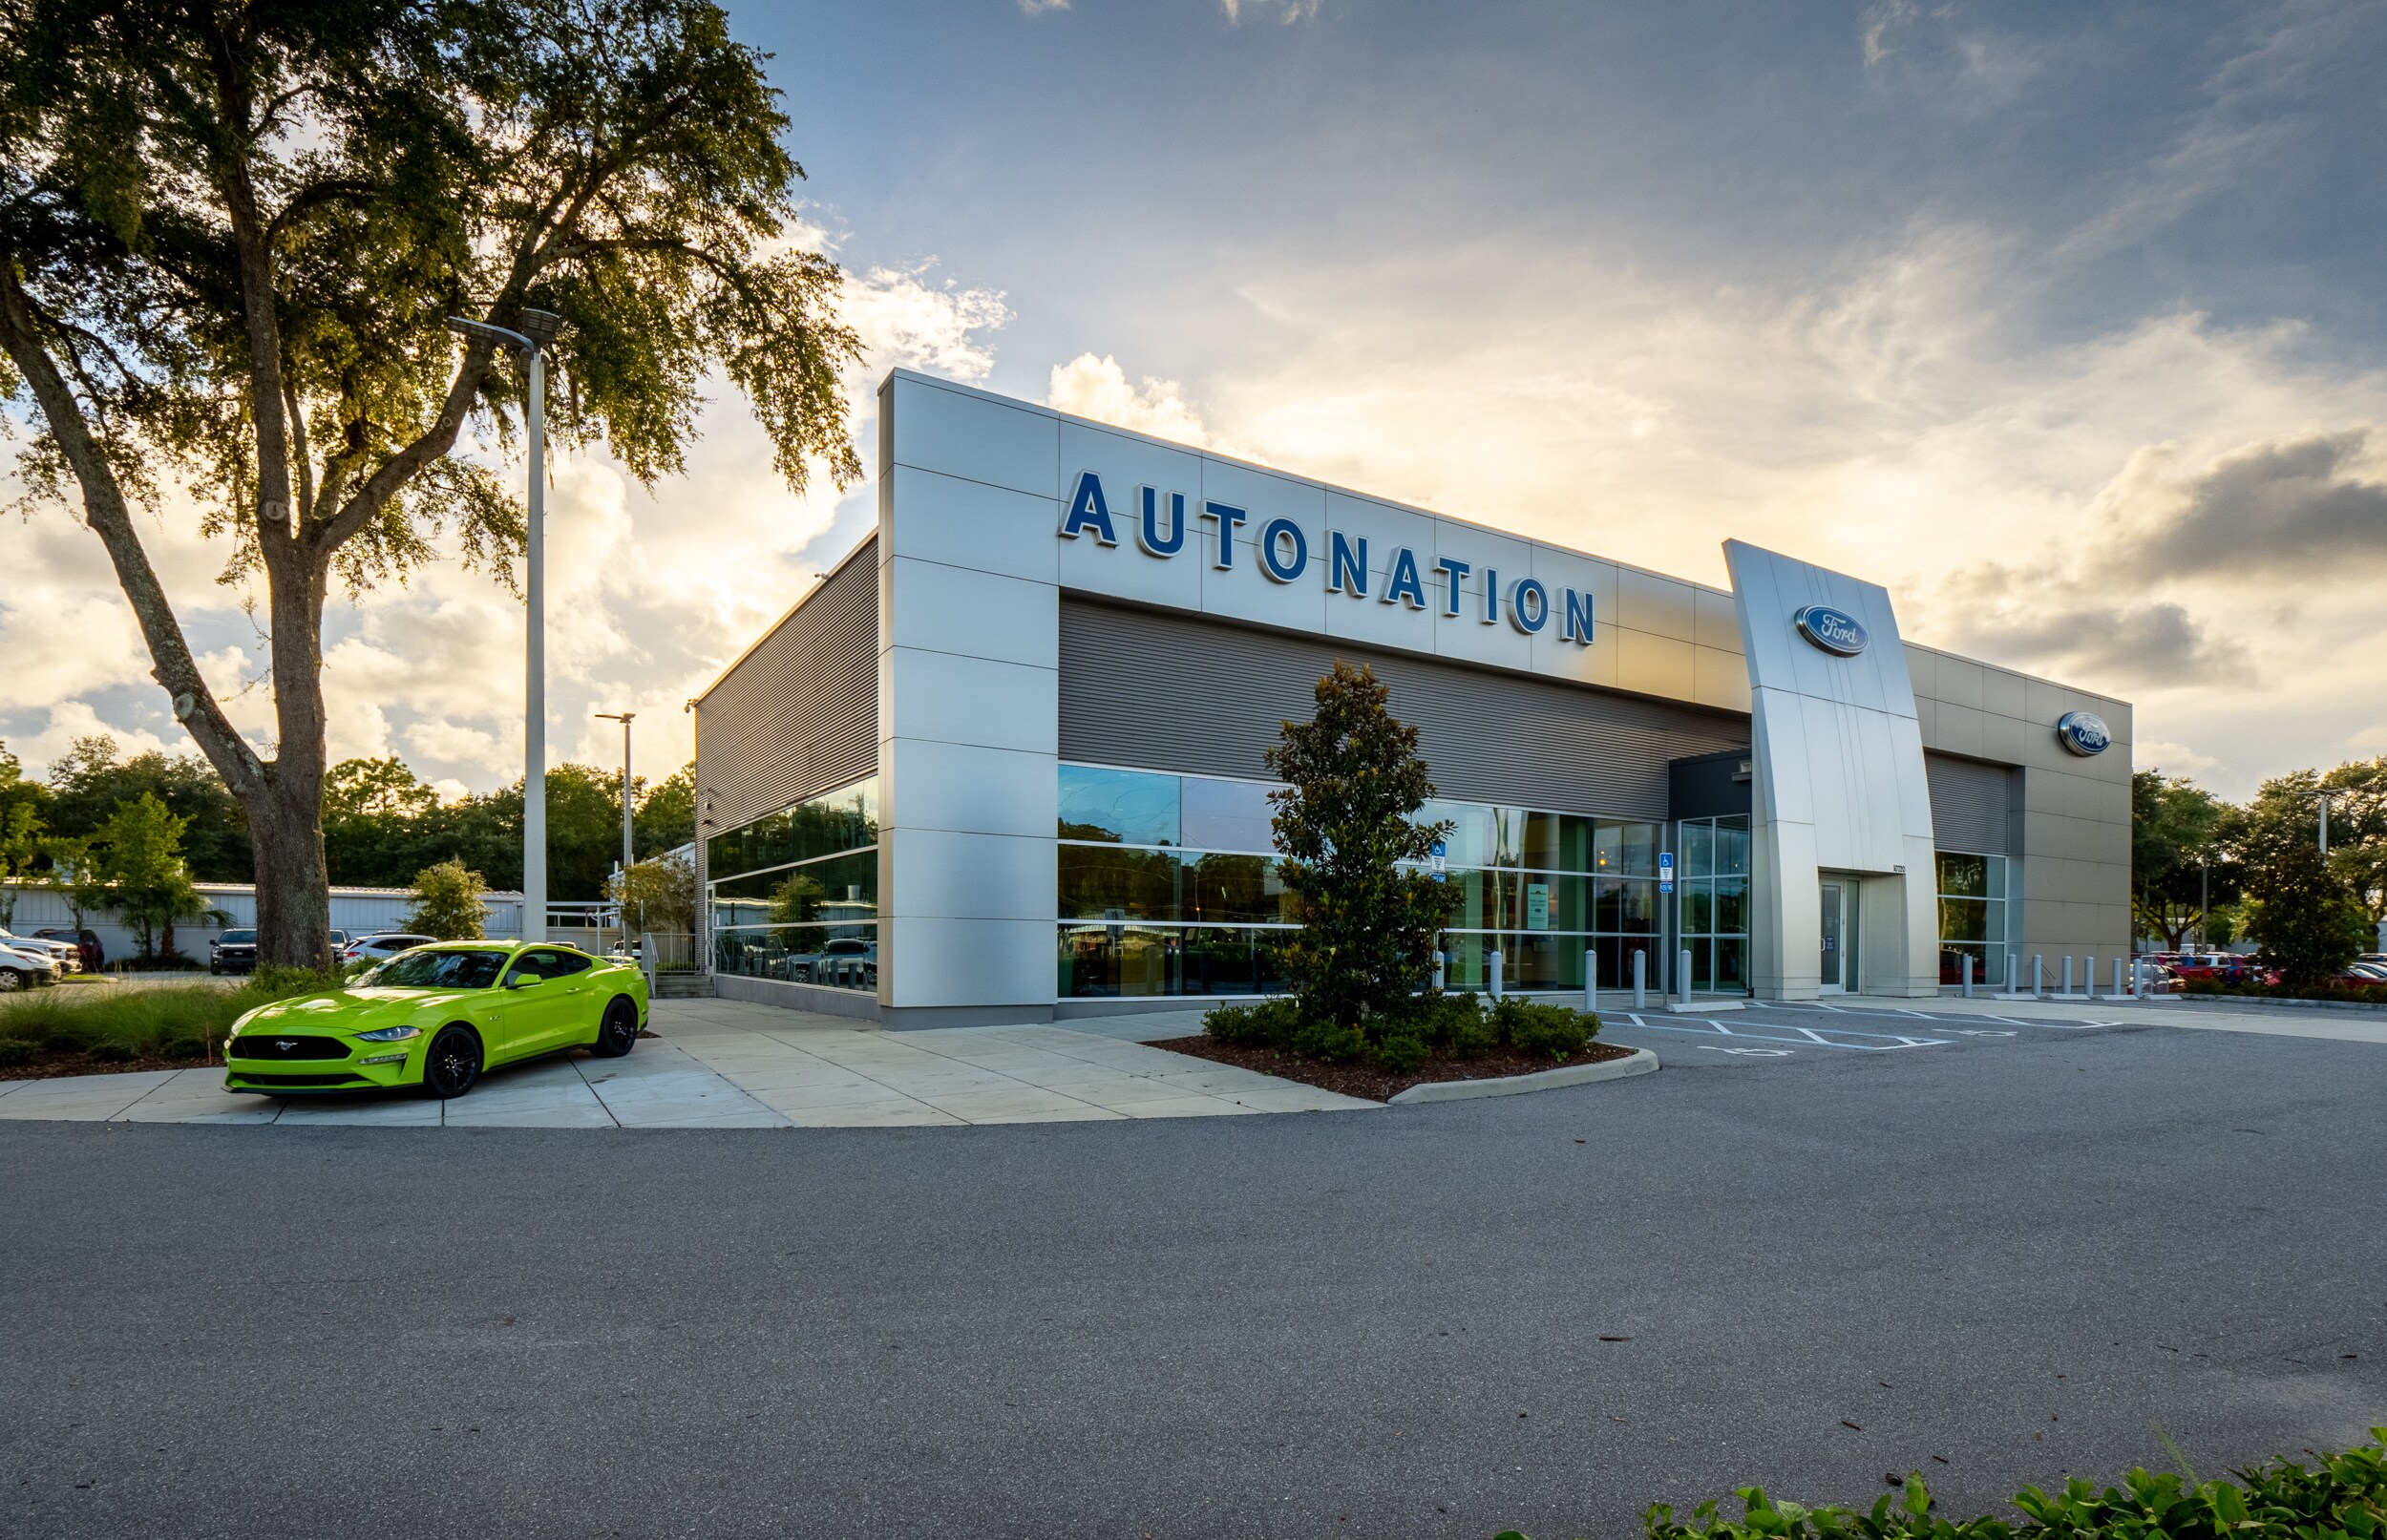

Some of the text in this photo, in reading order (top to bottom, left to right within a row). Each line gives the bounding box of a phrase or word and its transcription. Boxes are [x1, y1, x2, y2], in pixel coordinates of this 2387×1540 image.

[1059, 469, 1595, 644] AUTONATION
[1821, 614, 1857, 644] Ford
[2079, 721, 2104, 746] Ford
